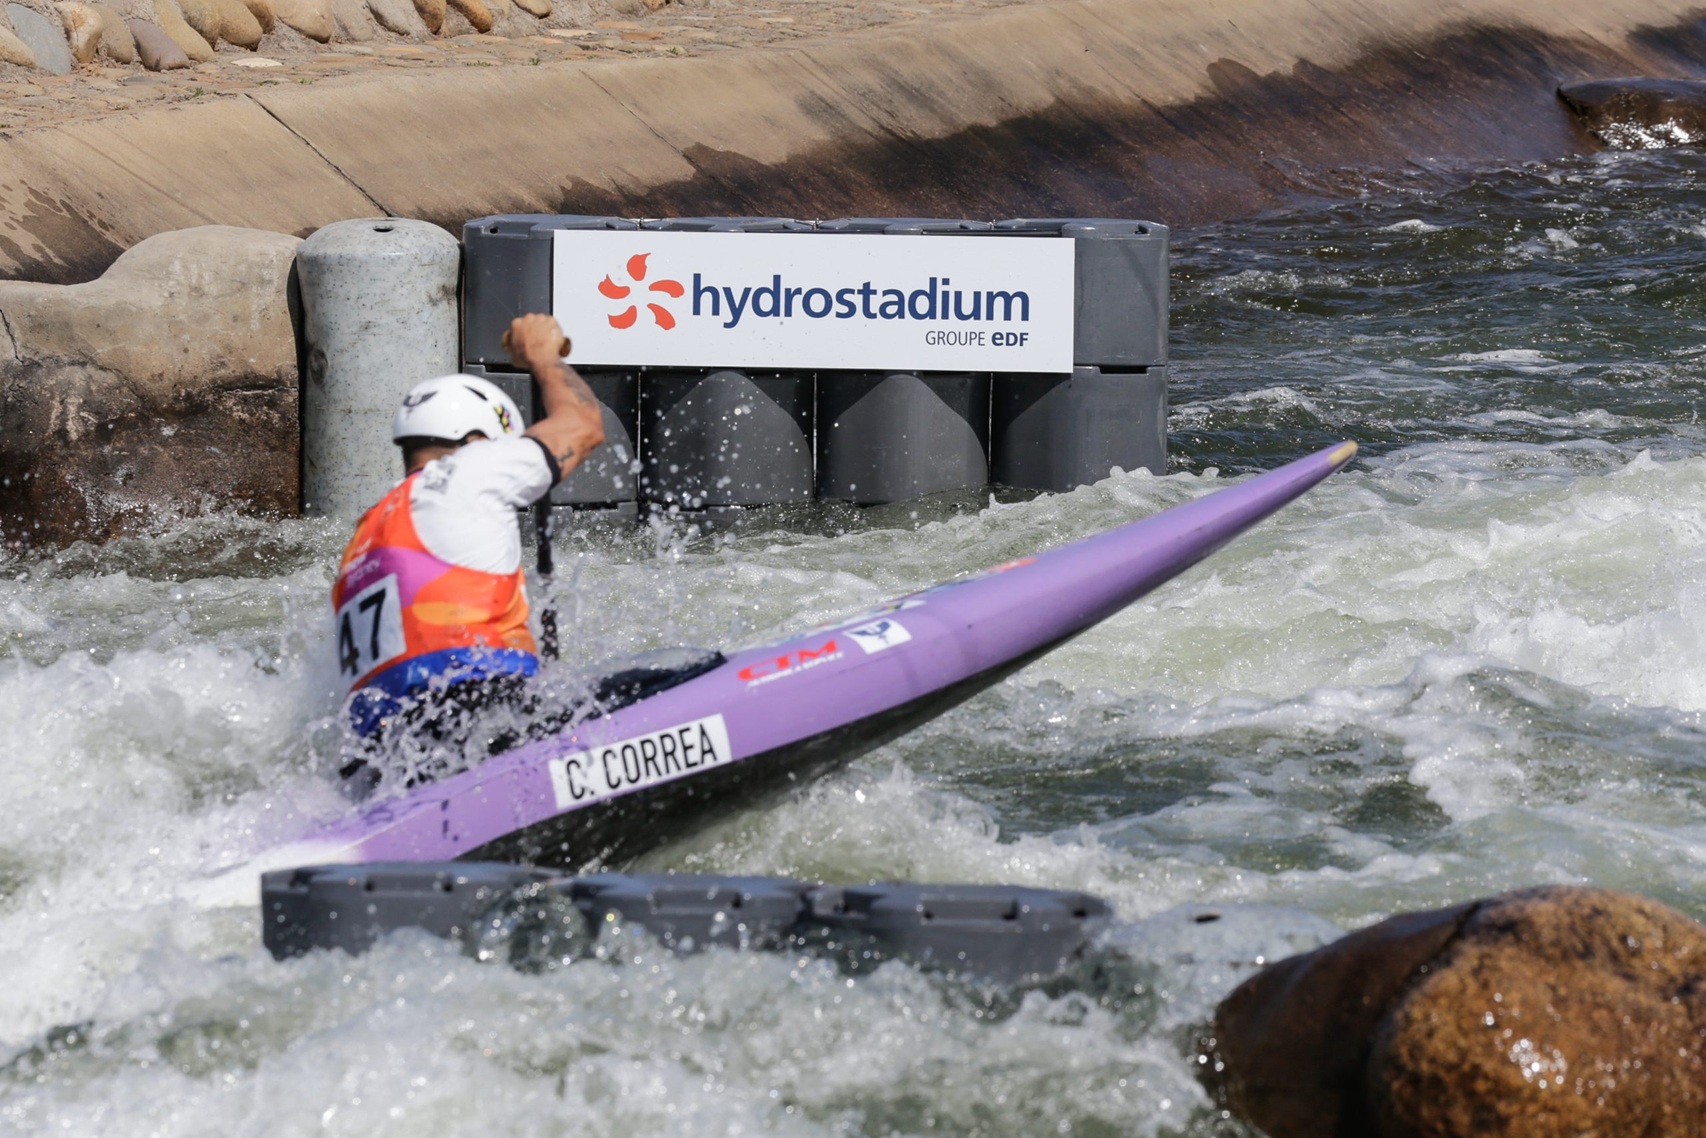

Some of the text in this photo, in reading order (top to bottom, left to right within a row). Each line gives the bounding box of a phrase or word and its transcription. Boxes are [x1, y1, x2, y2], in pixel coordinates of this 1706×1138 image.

[692, 274, 1030, 328] hydrostadium
[926, 330, 986, 347] GROUPE
[339, 586, 386, 677] 47
[565, 723, 717, 800] C. CORREA
